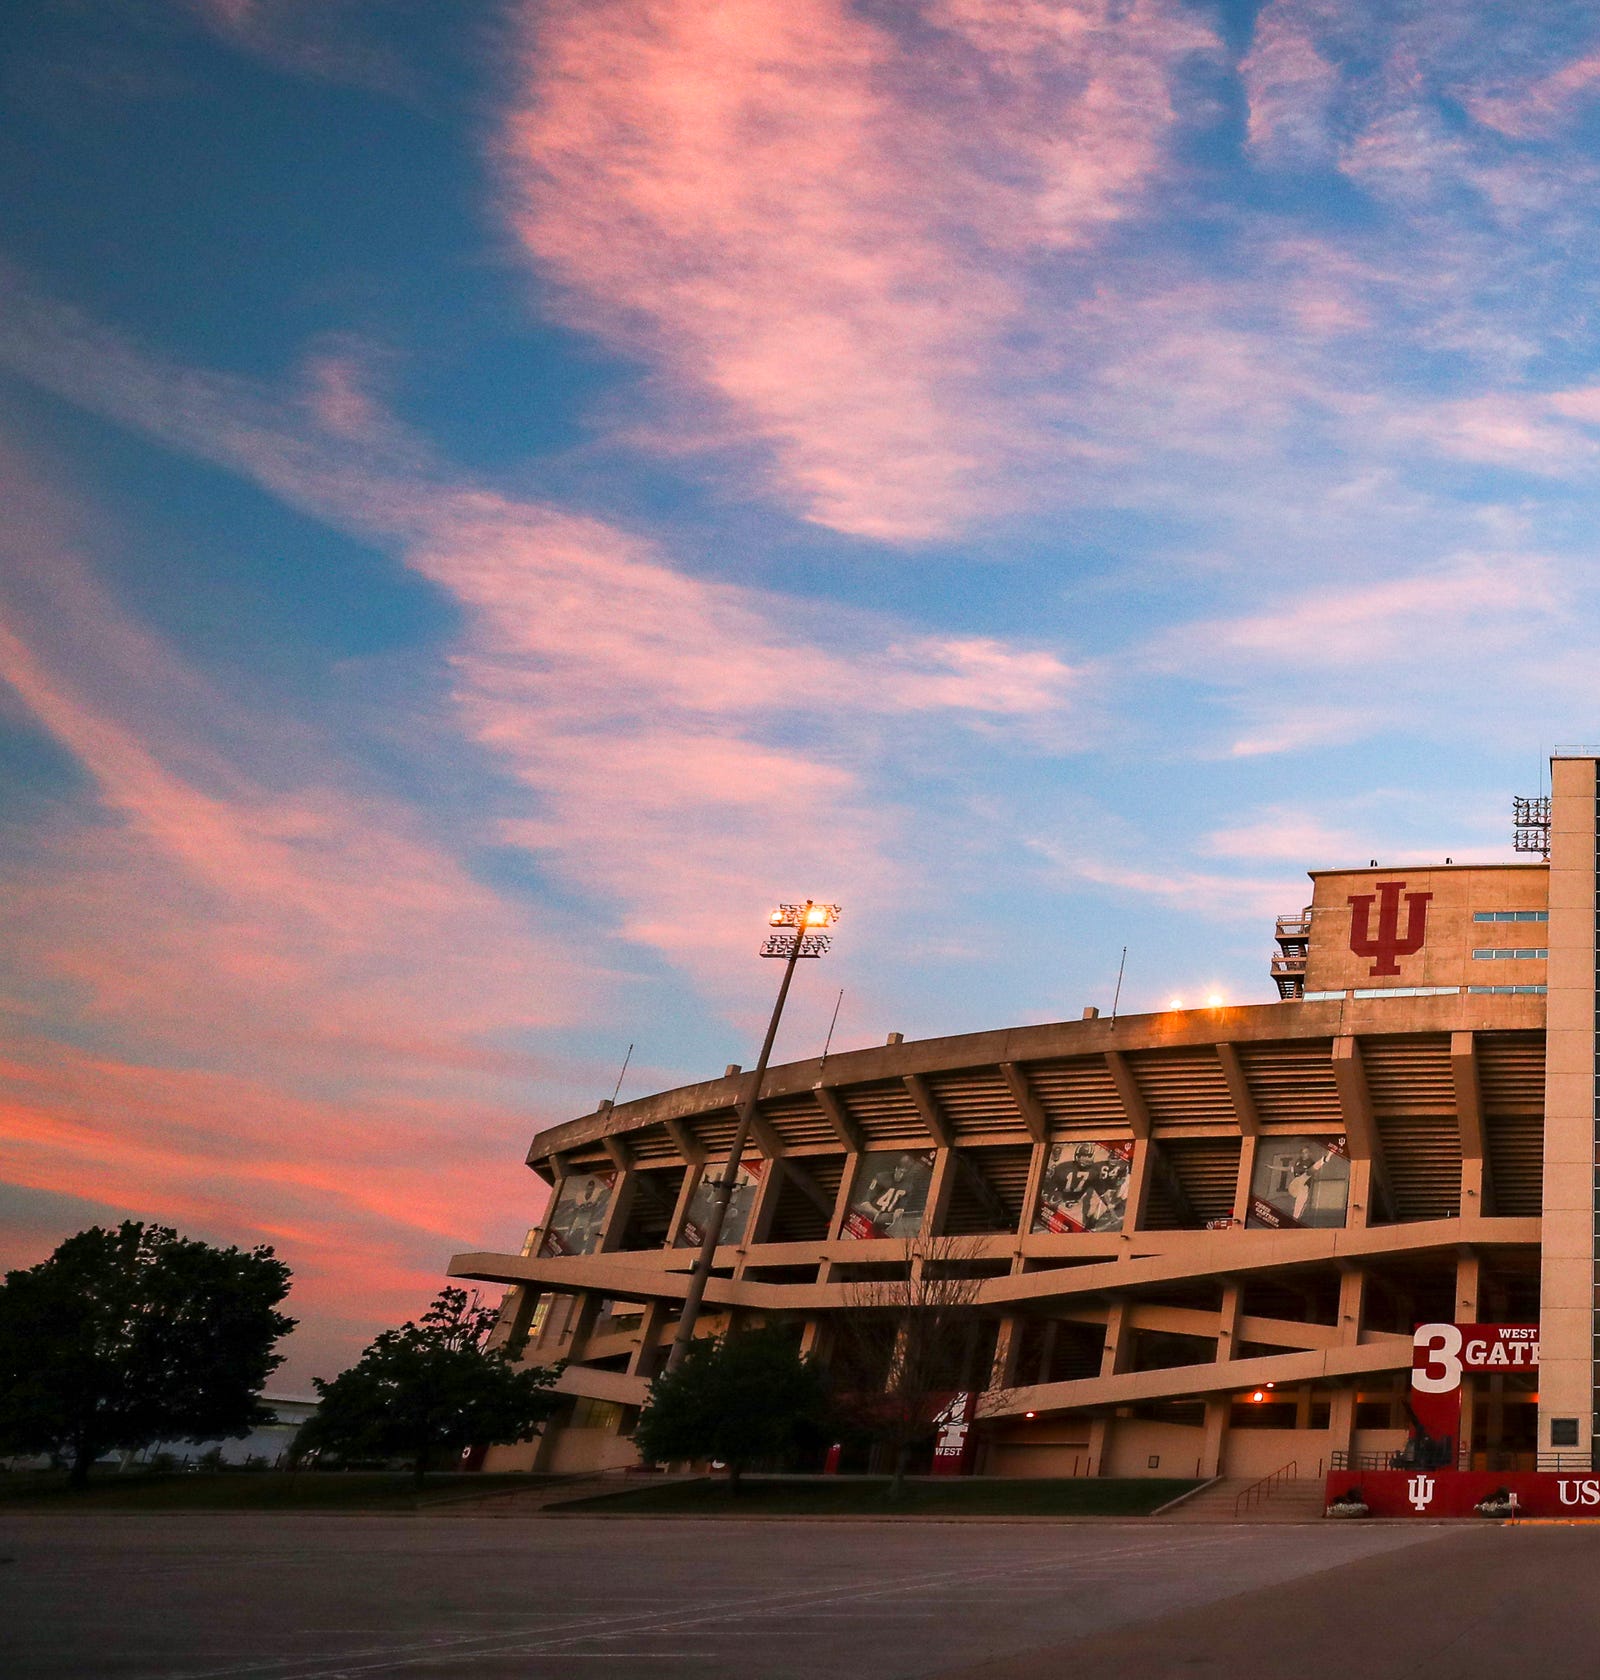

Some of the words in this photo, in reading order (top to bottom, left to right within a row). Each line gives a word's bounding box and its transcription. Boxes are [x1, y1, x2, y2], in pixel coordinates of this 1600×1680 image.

[1064, 1171, 1089, 1193] 17
[1498, 1329, 1537, 1338] WEST
[1411, 1323, 1463, 1393] 3
[932, 1392, 969, 1447] 4
[935, 1447, 963, 1456] WEST
